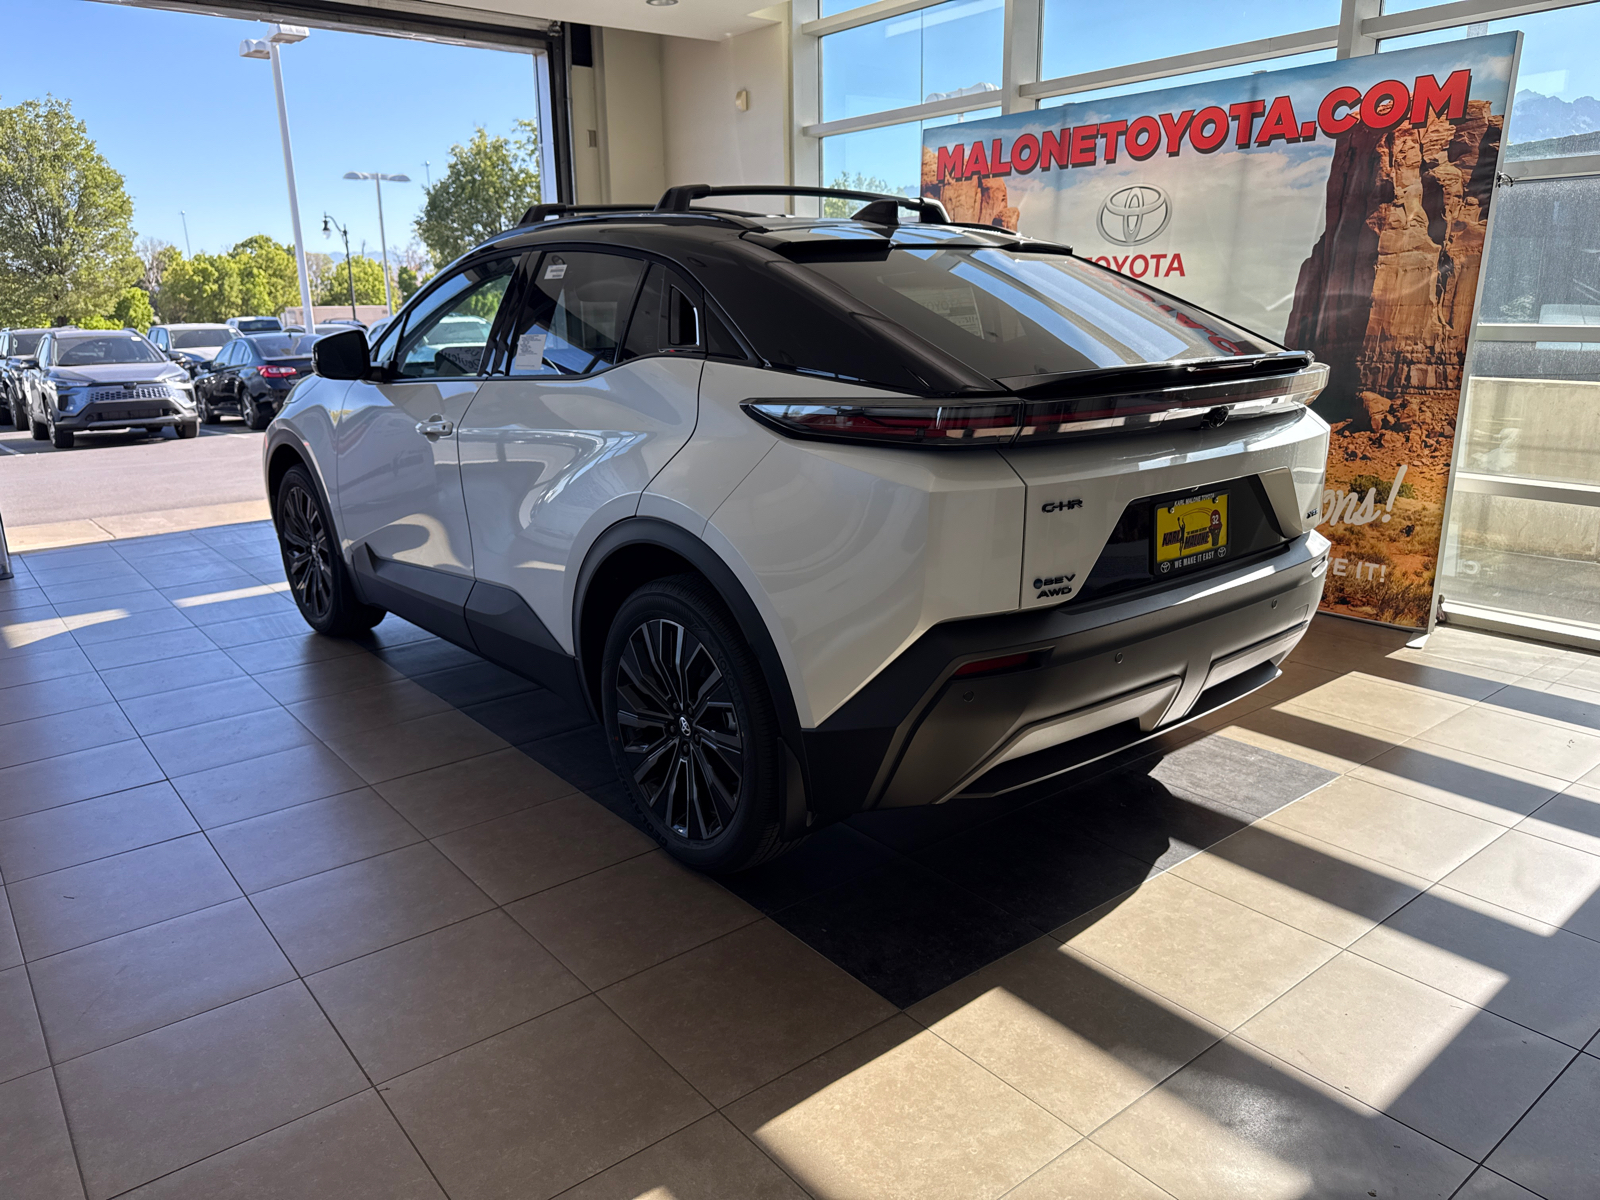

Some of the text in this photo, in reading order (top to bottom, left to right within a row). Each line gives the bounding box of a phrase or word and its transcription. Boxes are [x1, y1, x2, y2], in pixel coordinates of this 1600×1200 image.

[936, 69, 1472, 184] MALONETOYOTA.COM
[1041, 498, 1083, 513] C-HR
[1211, 514, 1219, 524] 32
[1162, 530, 1181, 547] KARL
[1184, 531, 1210, 550] MALONE
[1174, 560, 1182, 569] WE
[1183, 557, 1196, 566] MAKE
[1203, 551, 1215, 561] EASY
[1328, 556, 1387, 582] E IT!
[1036, 586, 1073, 600] AWD
